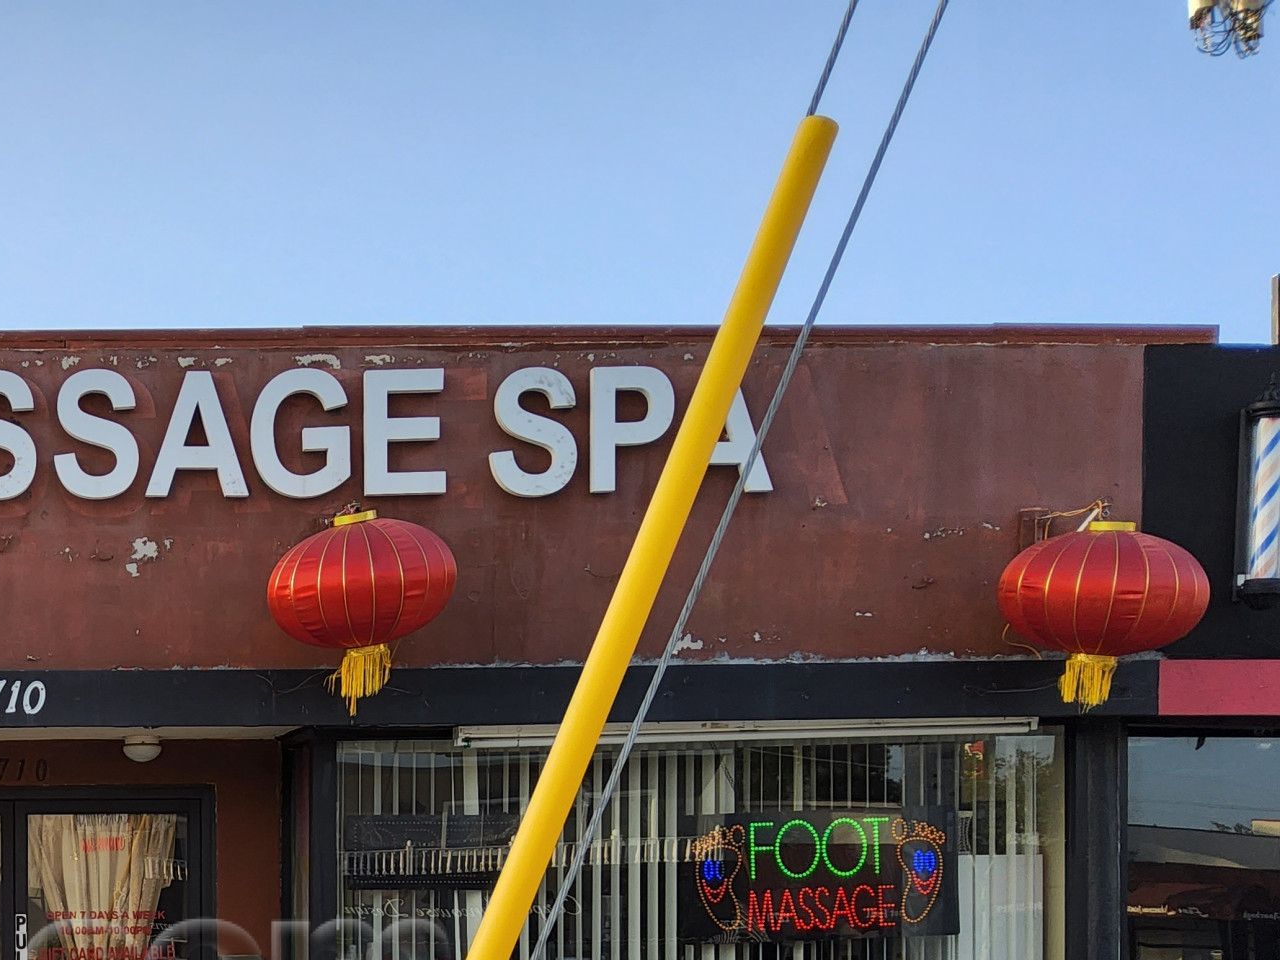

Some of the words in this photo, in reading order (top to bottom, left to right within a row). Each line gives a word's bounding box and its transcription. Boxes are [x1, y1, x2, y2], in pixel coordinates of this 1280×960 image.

[489, 365, 775, 498] SPA
[748, 816, 890, 881] FOOT
[46, 911, 76, 920] OPEN
[89, 911, 119, 920] DAYS
[121, 911, 130, 920] A
[132, 911, 166, 920] WEEK
[746, 884, 896, 932] MASSAGE
[107, 944, 175, 960] AVAILABLE
